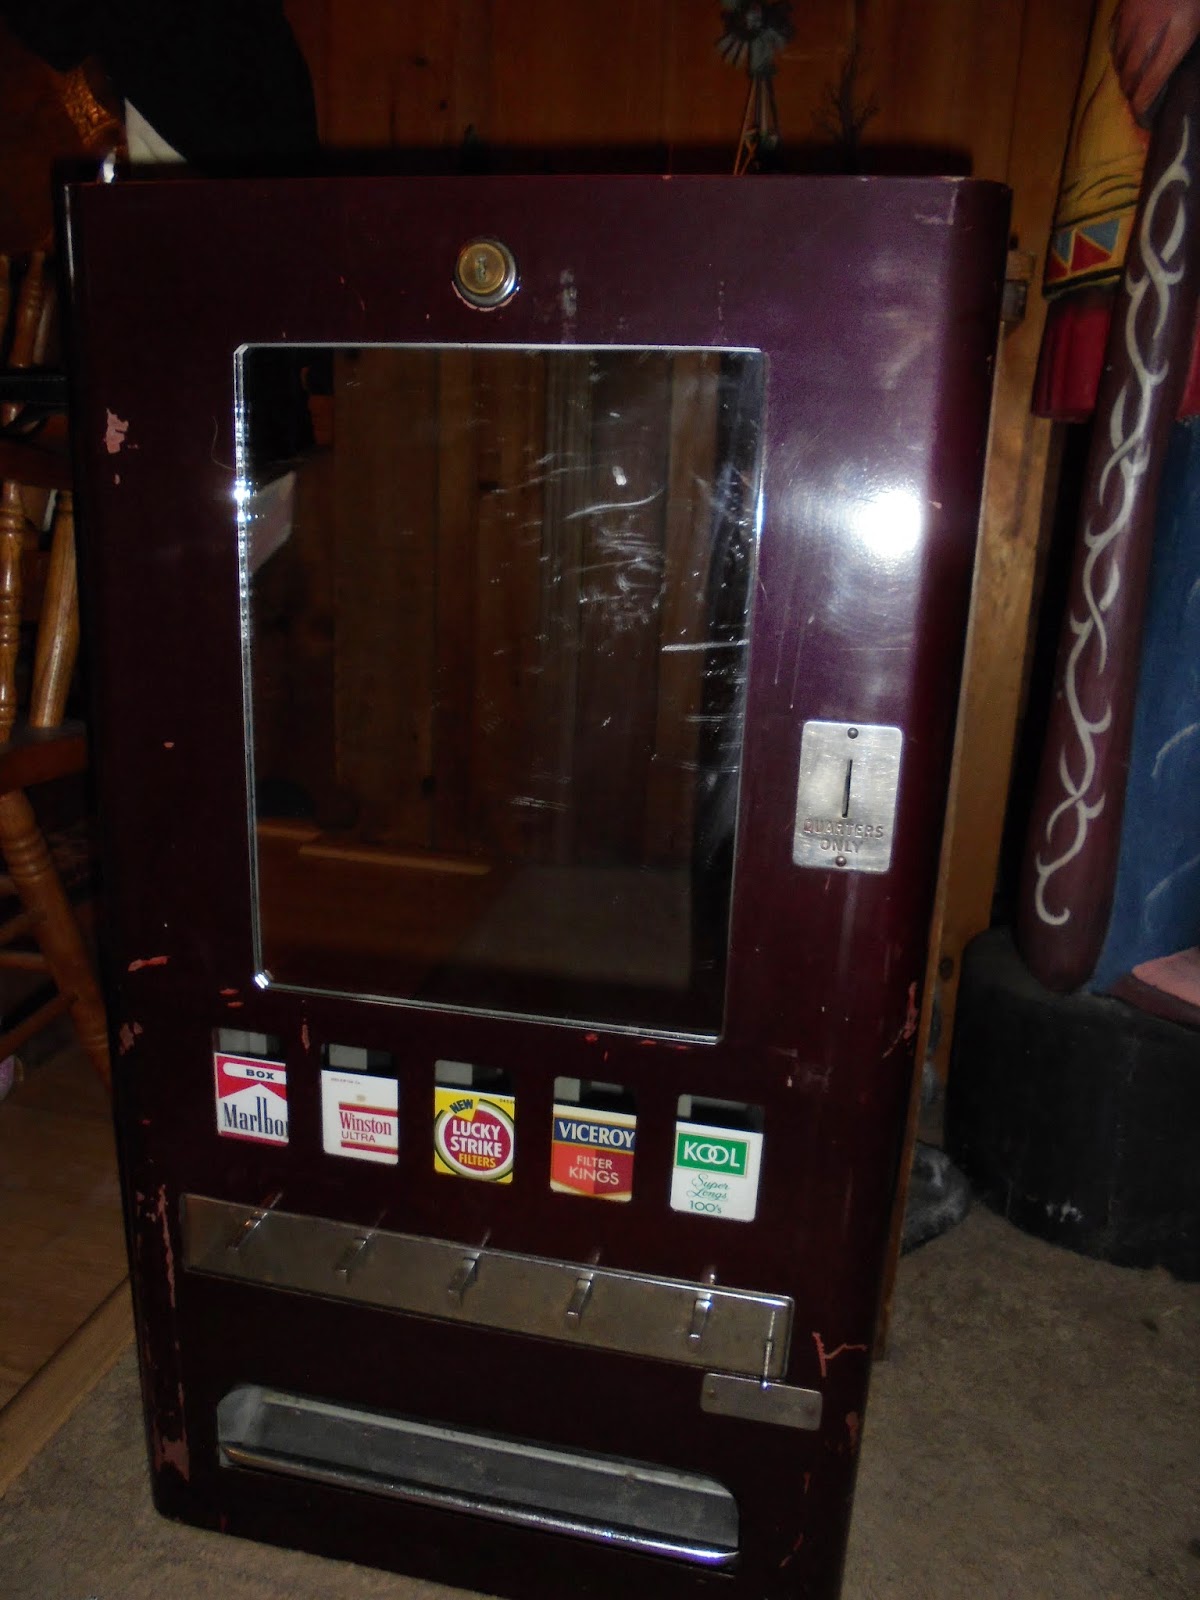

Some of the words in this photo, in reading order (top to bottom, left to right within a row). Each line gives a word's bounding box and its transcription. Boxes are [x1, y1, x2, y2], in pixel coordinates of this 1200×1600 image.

[803, 818, 884, 839] QUARTERS
[820, 838, 864, 853] ONLY
[246, 1068, 274, 1080] BOX
[449, 1098, 474, 1114] NEW
[339, 1111, 392, 1136] Winston
[452, 1119, 501, 1141] LUCKY
[341, 1130, 376, 1144] ULTRA
[558, 1121, 636, 1148] VICEROY
[450, 1136, 502, 1158] STRIKE
[683, 1140, 740, 1168] KOOL
[458, 1153, 497, 1169] FILTERS
[576, 1154, 613, 1170] FILTER
[568, 1165, 620, 1186] KINGS
[691, 1173, 730, 1190] Super
[686, 1186, 728, 1201] Longs
[689, 1200, 722, 1214] 100's
